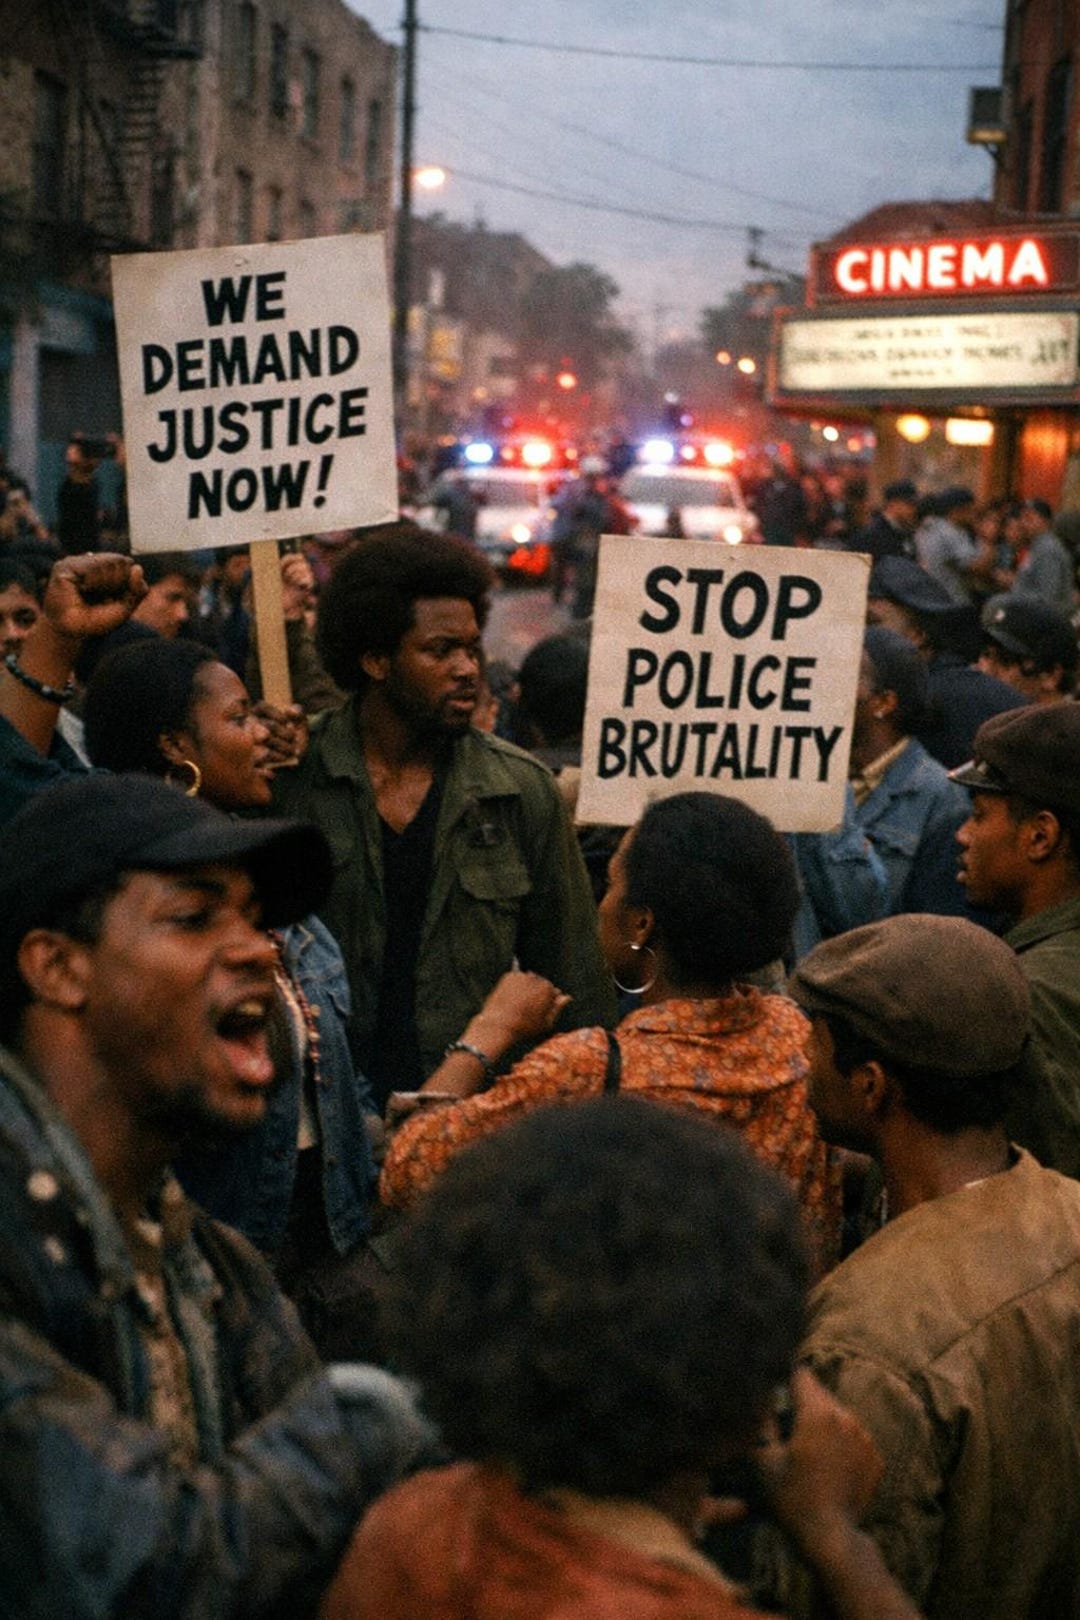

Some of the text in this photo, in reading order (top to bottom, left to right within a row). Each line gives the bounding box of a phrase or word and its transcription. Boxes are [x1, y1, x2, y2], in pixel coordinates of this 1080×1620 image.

[201, 271, 286, 327] WE
[835, 239, 1048, 293] CINEMA
[141, 325, 360, 396] DEMAND
[146, 387, 369, 464] JUSTICE
[188, 453, 334, 520] NOW!
[639, 565, 823, 641] STOP
[623, 647, 817, 713] POLICE
[599, 717, 844, 782] BRUTALITY
